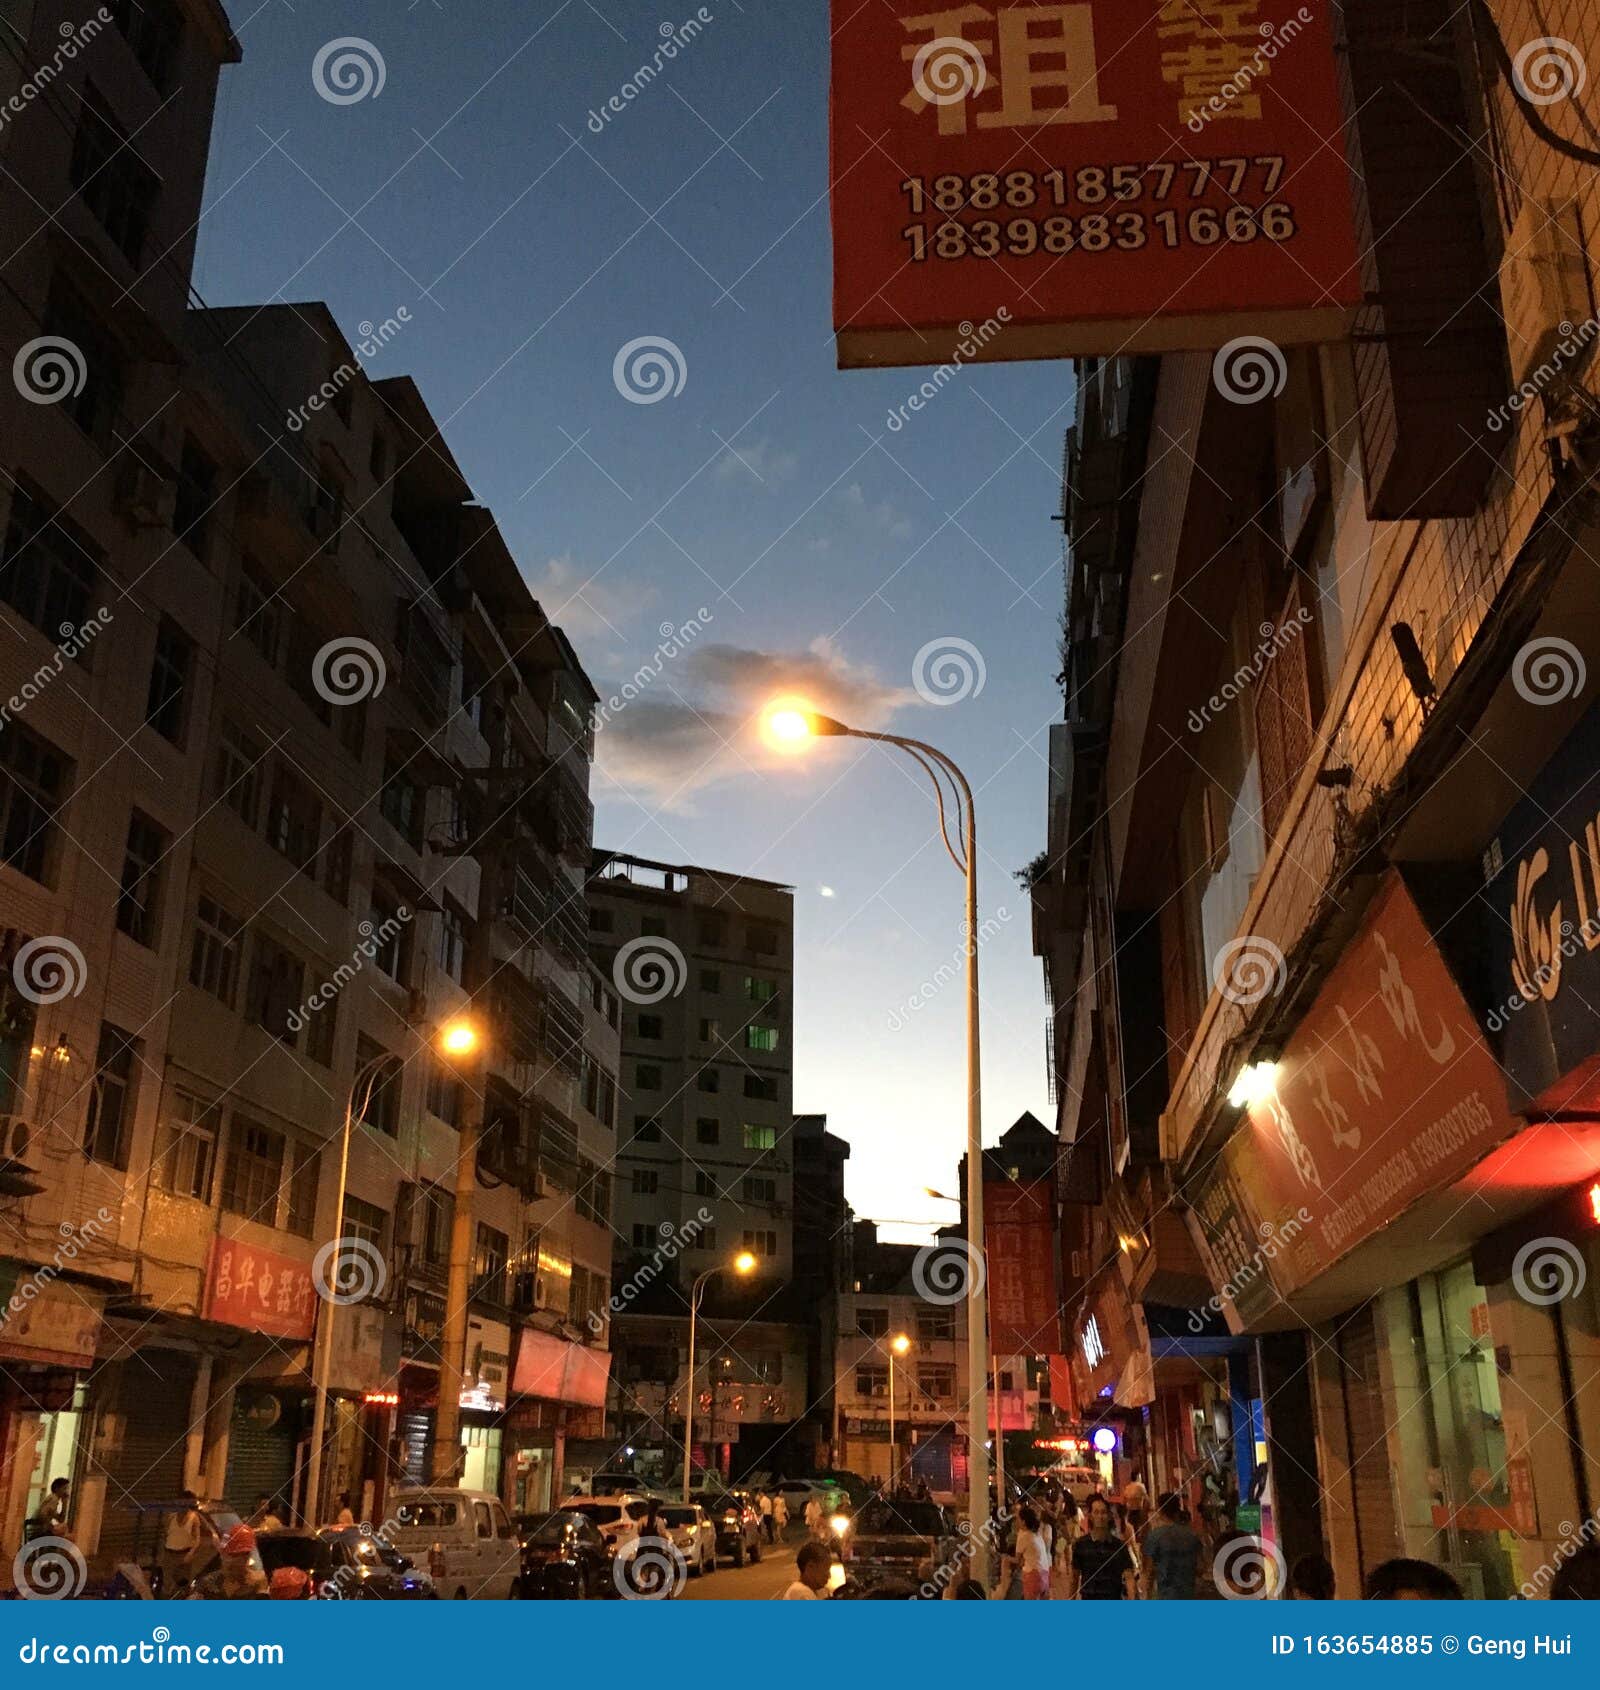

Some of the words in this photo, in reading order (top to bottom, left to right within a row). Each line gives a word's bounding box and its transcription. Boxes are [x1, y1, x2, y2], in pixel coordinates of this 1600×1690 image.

[899, 3, 1119, 137] 租
[901, 154, 1287, 215] 18881857777
[901, 201, 1297, 263] 18398831666
